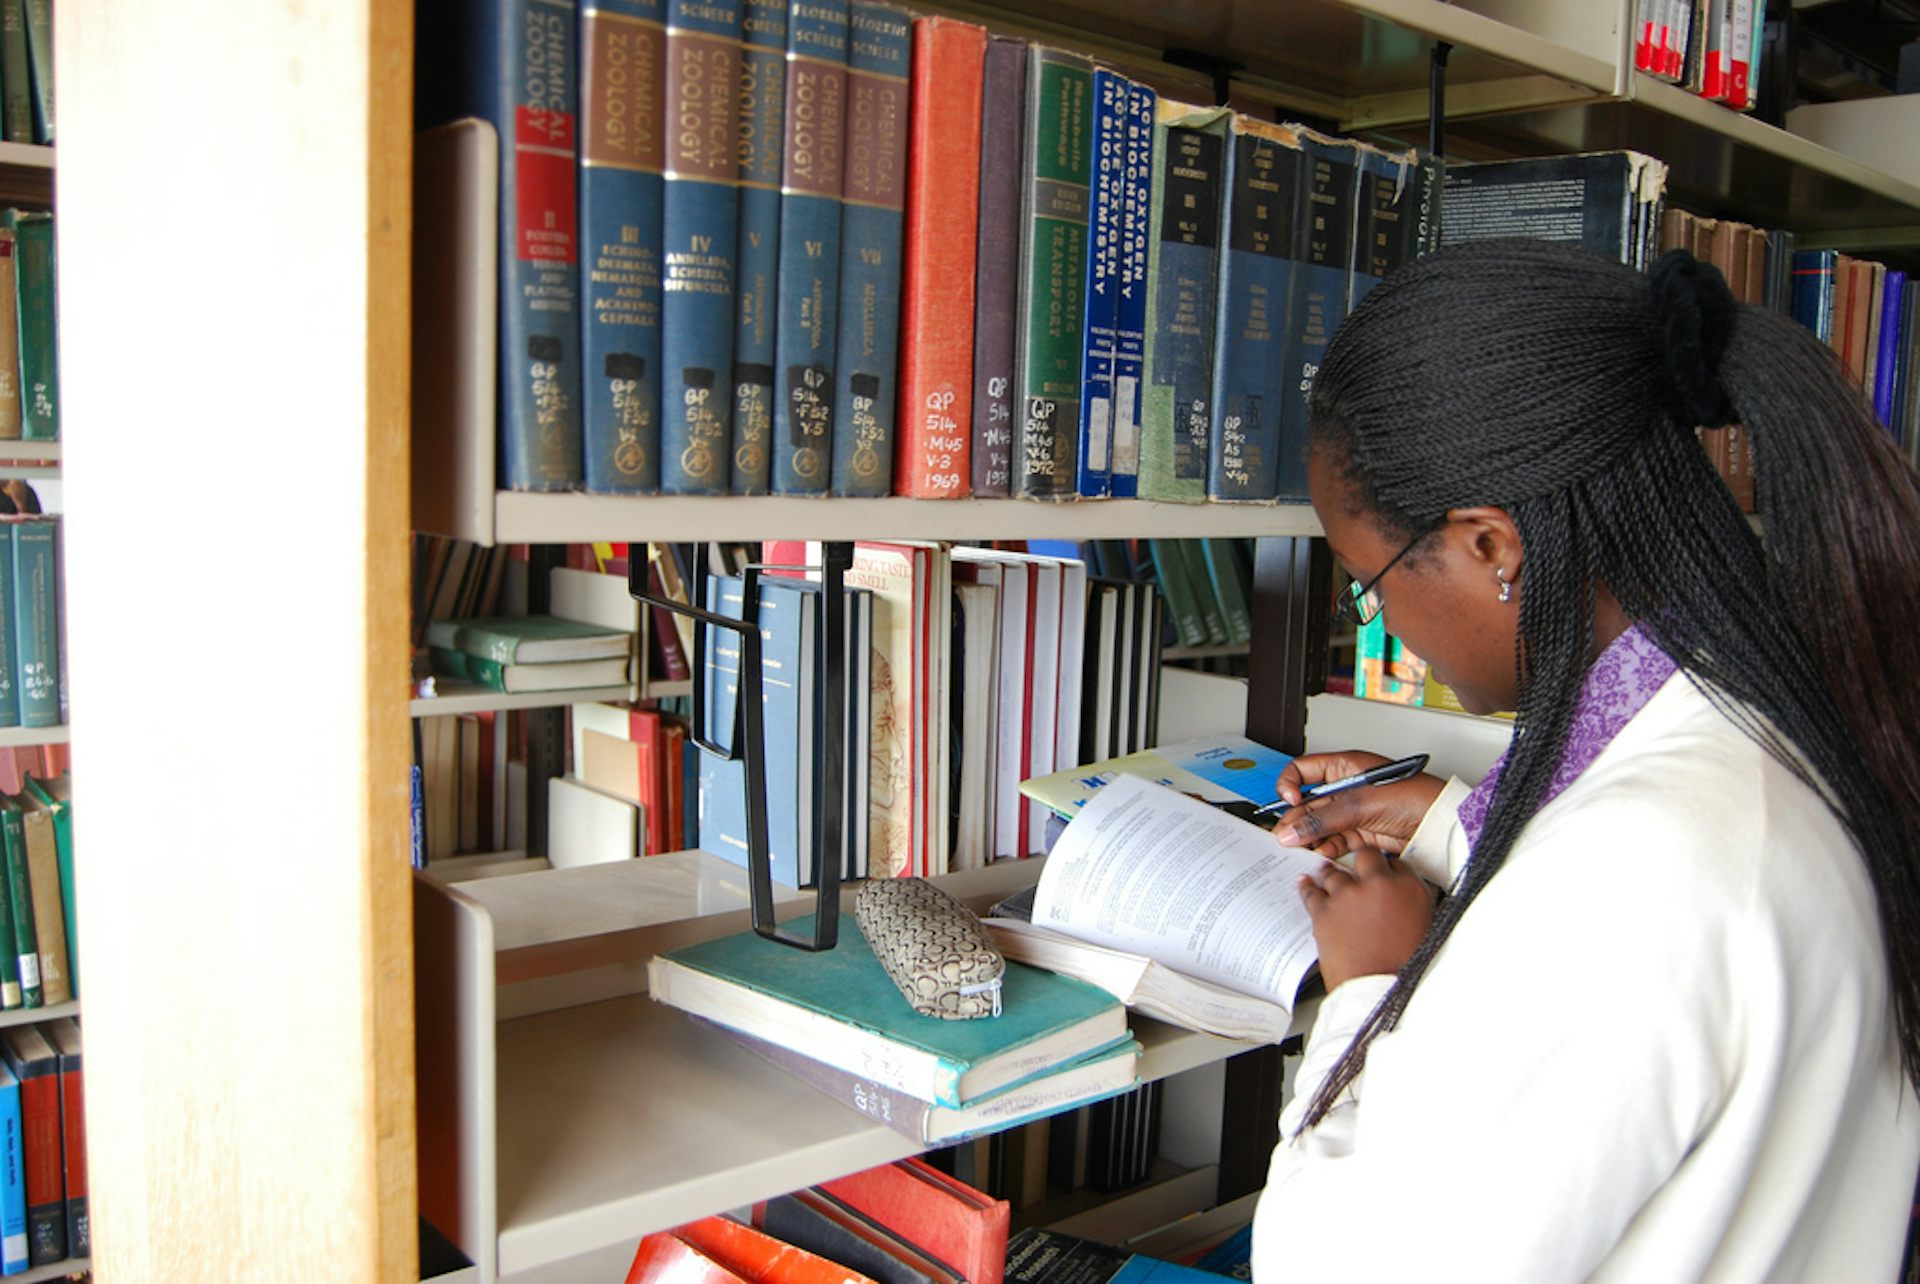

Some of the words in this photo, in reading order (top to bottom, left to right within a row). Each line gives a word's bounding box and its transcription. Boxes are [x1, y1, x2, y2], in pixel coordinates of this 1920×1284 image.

[743, 18, 786, 35] CHEER
[527, 11, 546, 132] ZOOLOGY
[548, 16, 565, 140] CHEMICAL
[606, 32, 627, 150] ZOOLOGY
[633, 34, 653, 156] CHEMICAL
[680, 49, 704, 164] ZOOLOGY
[708, 50, 730, 168] CHEMICAL
[1103, 80, 1113, 106] IN
[1129, 91, 1141, 116] IN
[737, 62, 757, 171] ZOOLOGY
[762, 62, 782, 175] CHEMICAL
[793, 72, 817, 179] ZOOLOGY
[818, 74, 839, 185] CHEMICAL
[852, 87, 873, 191] ZOOLOGY
[875, 88, 896, 195] CHEMICAL
[1112, 85, 1125, 170] ACTIVE
[1139, 95, 1151, 178] ACTIVE
[621, 225, 639, 243] III
[691, 235, 711, 252] IV
[749, 231, 760, 248] V
[1094, 115, 1113, 295] BIOCHEMISTRY
[1107, 180, 1121, 276] OXYGEN
[1122, 125, 1139, 299] BIOCHEMISTRY
[1133, 188, 1147, 281] OXYGEN
[805, 240, 822, 256] VI
[861, 248, 881, 265] VII
[1049, 225, 1064, 337] TRANSPORT
[863, 283, 875, 356] MOLLUSCA
[685, 388, 709, 405] QP
[804, 368, 824, 388] QP
[852, 396, 873, 412] QP
[926, 391, 955, 410] QP
[988, 377, 1007, 398] QP
[1032, 399, 1055, 419] QP
[926, 414, 957, 433] 514
[1025, 419, 1050, 433] 514
[924, 473, 960, 489] 1969
[1024, 460, 1055, 475] 1972
